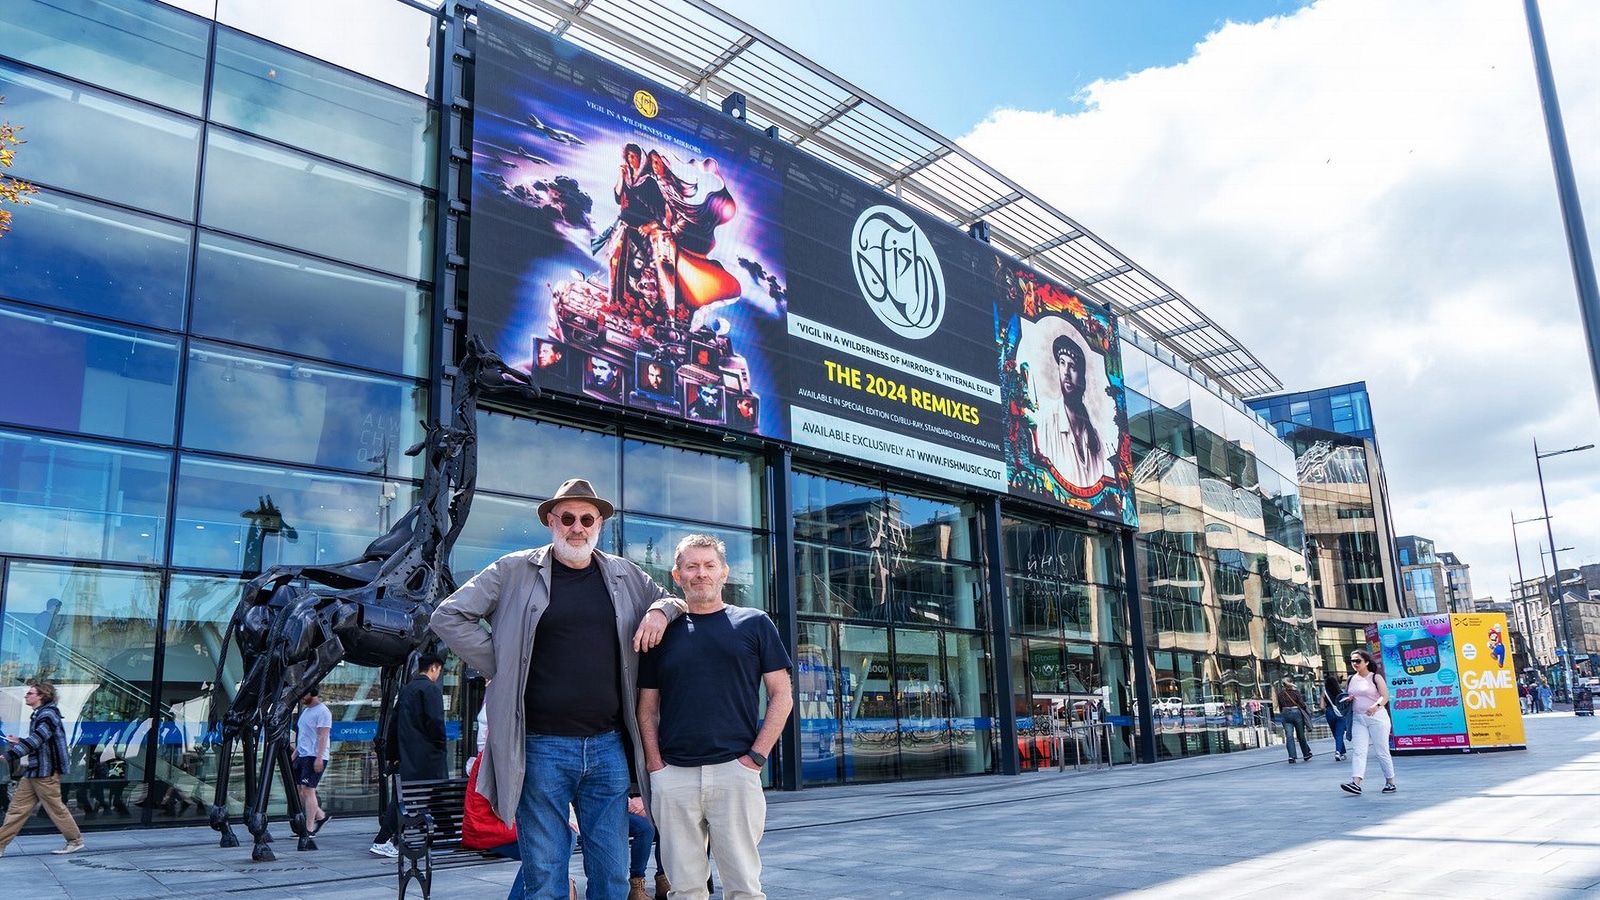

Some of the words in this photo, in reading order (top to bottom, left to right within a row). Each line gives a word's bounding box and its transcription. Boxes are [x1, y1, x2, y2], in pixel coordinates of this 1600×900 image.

[586, 100, 605, 114] VIGIL
[606, 108, 615, 118] IN
[622, 115, 663, 138] WILDERNESS
[663, 133, 672, 142] OF
[673, 137, 702, 154] MIRRORS
[822, 331, 832, 342] IN
[833, 335, 840, 345] A
[841, 338, 889, 361] WILDERNESS
[890, 357, 900, 365] OF
[936, 370, 942, 378] &
[824, 360, 862, 390] THE
[865, 373, 908, 404] 2024
[911, 387, 980, 426] REMIXES
[798, 388, 832, 404] AVAILABLE
[833, 397, 841, 406] IN
[841, 400, 865, 414] SPECIAL
[866, 406, 890, 420] EDITION
[925, 423, 953, 438] STANDARD
[953, 431, 961, 440] CD
[961, 434, 976, 443] BOOK
[976, 439, 988, 448] AND
[988, 442, 1001, 452] VINYL
[802, 422, 850, 443] AVAILABLE
[852, 434, 904, 456] EXCLUSIVELY
[905, 448, 915, 458] AT
[917, 450, 1001, 480] WWW.FISHMUSIC.SCOT
[1404, 645, 1436, 660] QUEER
[1405, 655, 1437, 667] COMEDY
[1407, 665, 1424, 674] CLUB
[1462, 669, 1513, 690] GAME
[1395, 687, 1418, 698] BEST
[1420, 686, 1433, 697] OF
[1435, 684, 1454, 696] THE
[1465, 690, 1496, 710] ON
[1394, 699, 1422, 711] QUEER
[1425, 696, 1459, 708] FRINGE
